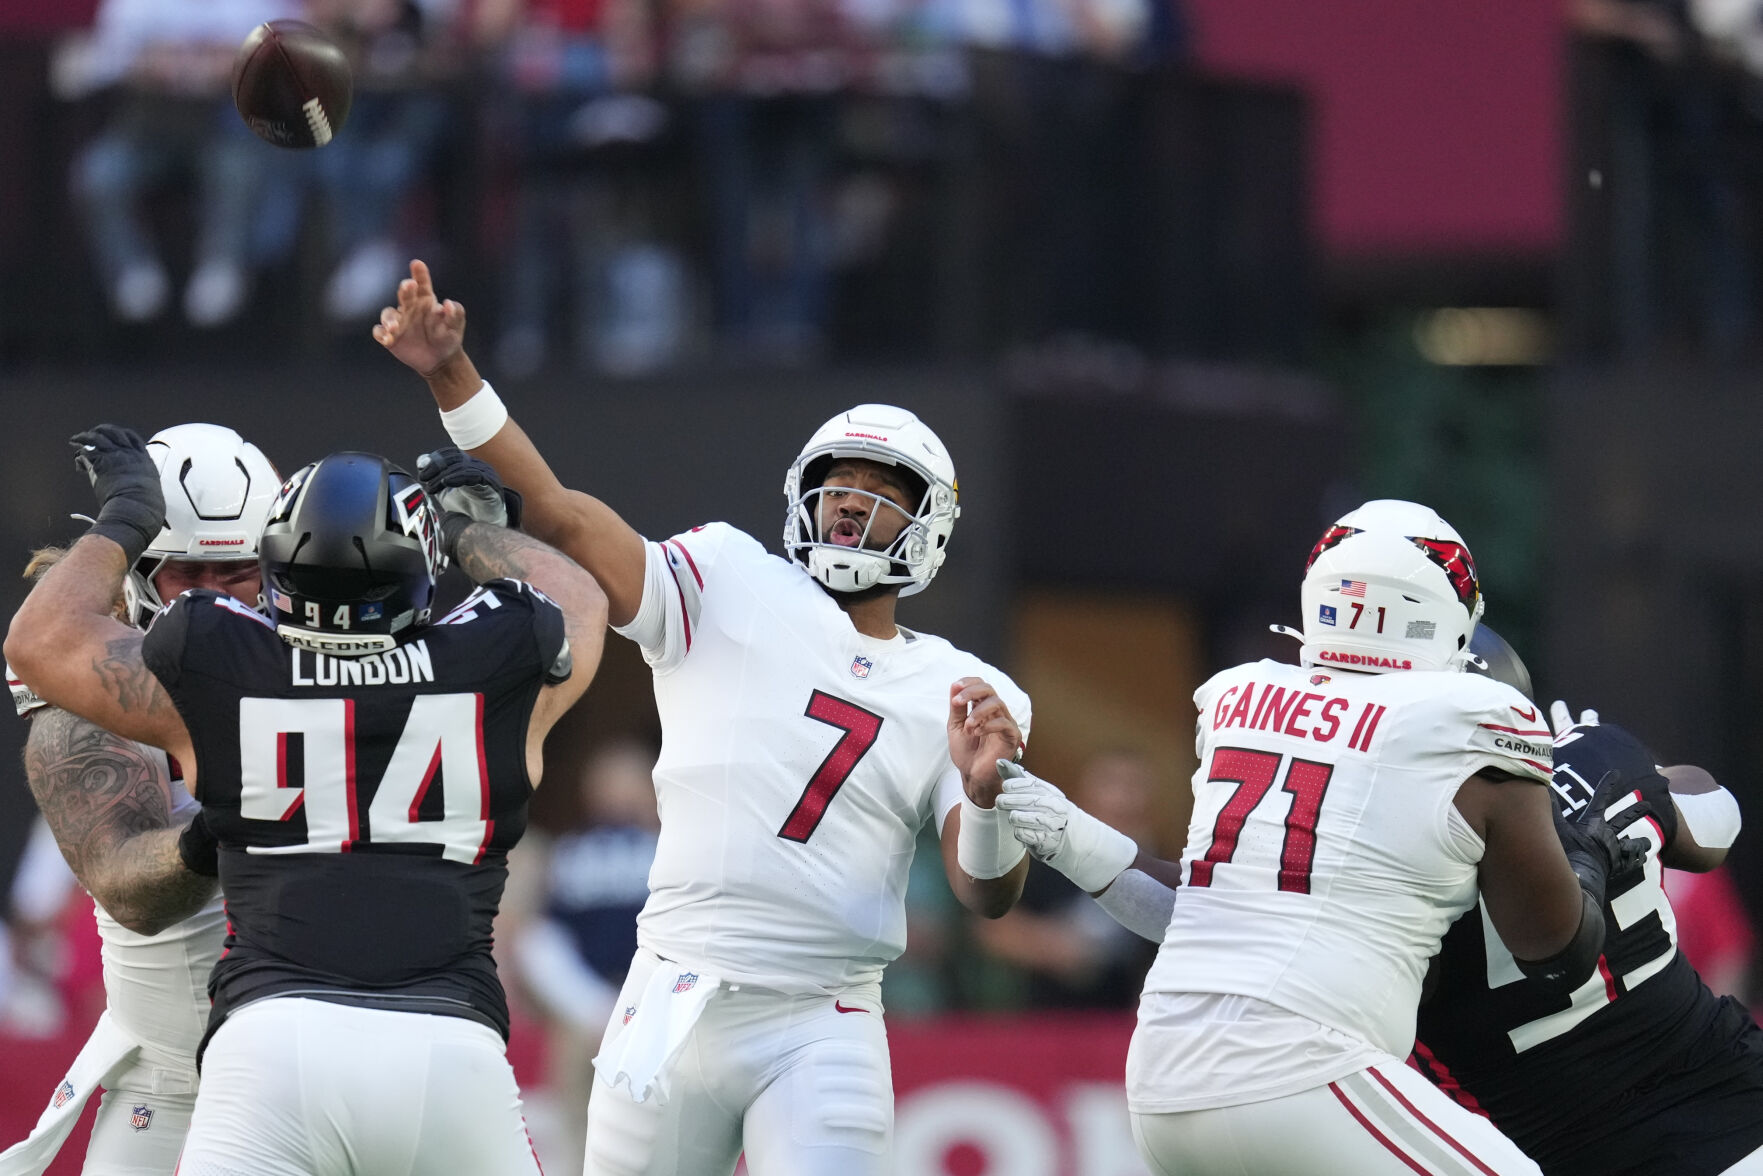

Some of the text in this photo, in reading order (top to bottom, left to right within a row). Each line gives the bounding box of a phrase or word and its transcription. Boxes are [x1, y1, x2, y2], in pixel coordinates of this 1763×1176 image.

[845, 432, 888, 442] CARDINALS
[281, 634, 385, 651] FALCONS
[1319, 650, 1412, 670] CARDINALS
[1212, 681, 1350, 743] GAINES
[239, 692, 495, 866] 94
[777, 688, 885, 845] 7
[1188, 745, 1335, 895] 71
